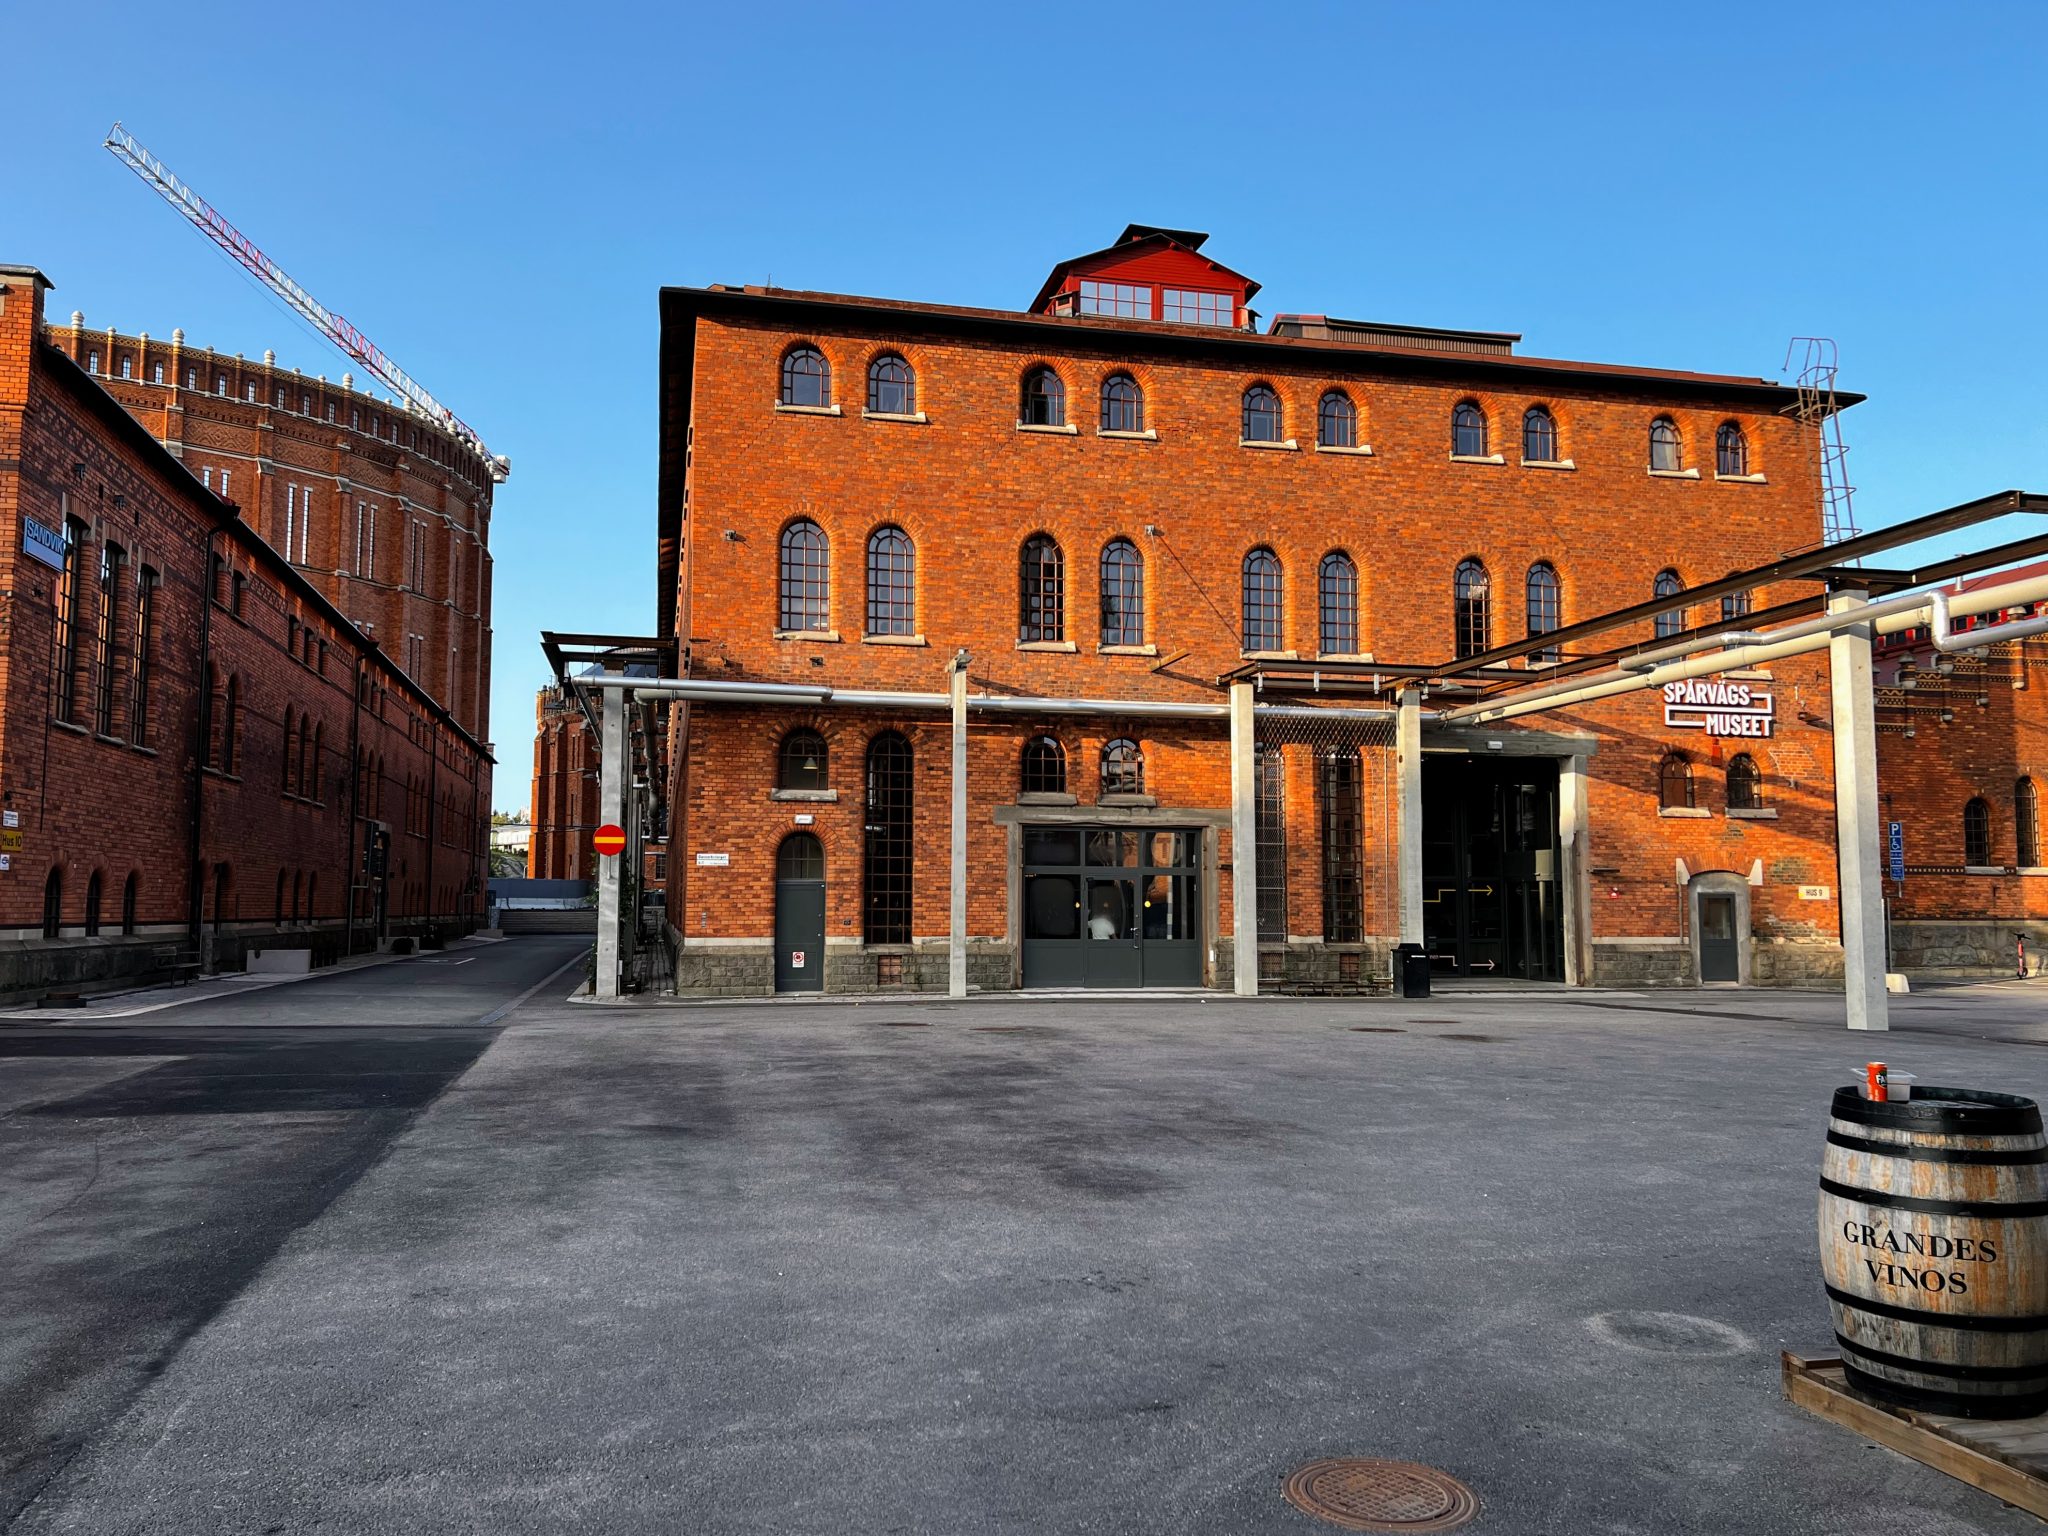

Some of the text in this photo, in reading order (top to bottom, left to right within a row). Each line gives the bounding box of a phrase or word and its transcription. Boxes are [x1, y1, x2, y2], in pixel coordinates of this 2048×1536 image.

[27, 520, 63, 554] SANDVIK
[1664, 679, 1750, 705] SPÅRVÄGS
[1706, 714, 1772, 736] MUSEET
[2, 834, 22, 847] Hus 10
[1891, 823, 1899, 836] P
[1805, 889, 1818, 897] HUS
[1844, 1221, 1997, 1263] GRANDES
[1864, 1259, 1968, 1295] VINOS
